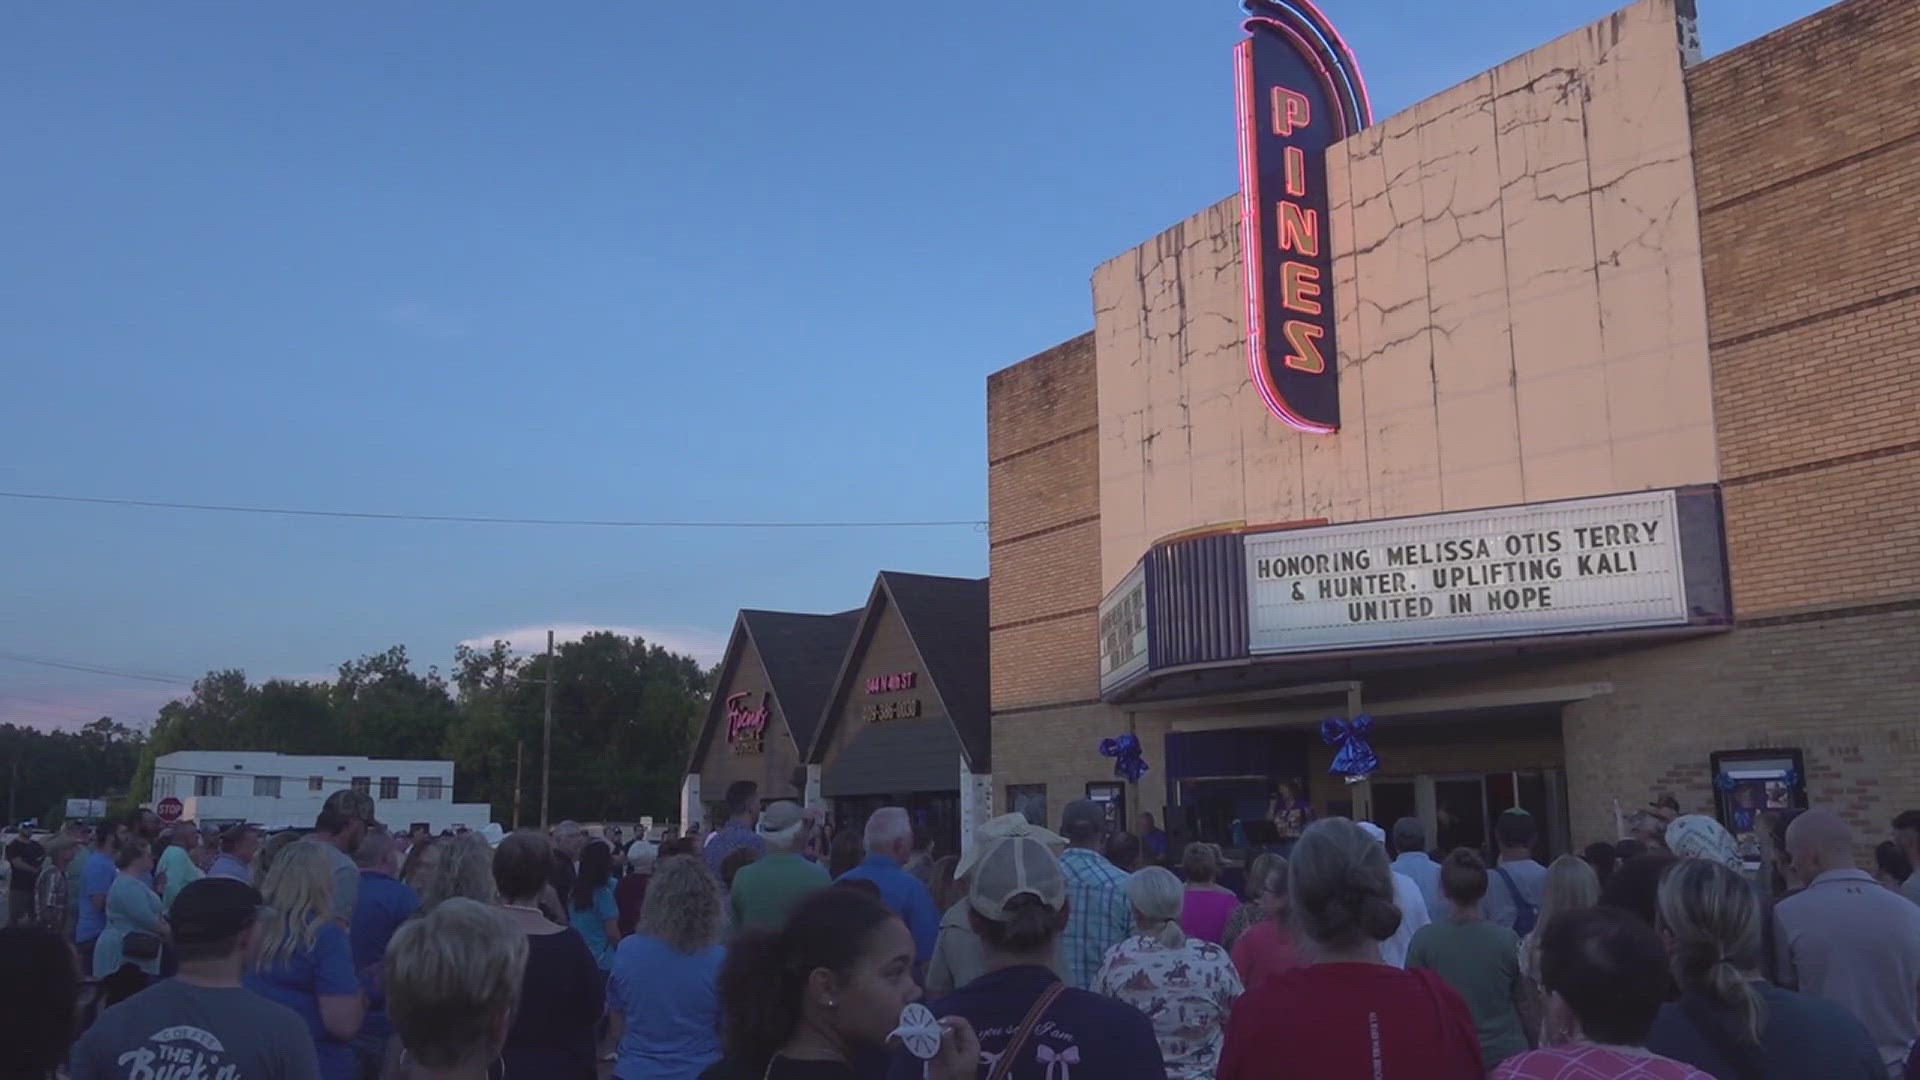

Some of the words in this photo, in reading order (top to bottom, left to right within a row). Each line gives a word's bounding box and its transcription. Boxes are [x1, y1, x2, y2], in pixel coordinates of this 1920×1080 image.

[1271, 86, 1324, 374] PINES
[1257, 549, 1370, 579] HONORING
[1387, 538, 1491, 567] MELISSA
[1505, 531, 1562, 556] OTIS
[1573, 520, 1659, 549] TERRY
[1291, 581, 1304, 601] &
[1319, 572, 1417, 599] HUNTER.
[1433, 558, 1562, 589] UPLIFTING
[1578, 551, 1638, 576] KALI
[1349, 597, 1433, 622] UNITED
[1450, 593, 1472, 614] IN
[1487, 587, 1552, 612] HOPE
[159, 804, 182, 815] STOP
[162, 1029, 219, 1050] COFFEE
[1051, 1031, 1074, 1043] am
[158, 1045, 194, 1064] THE
